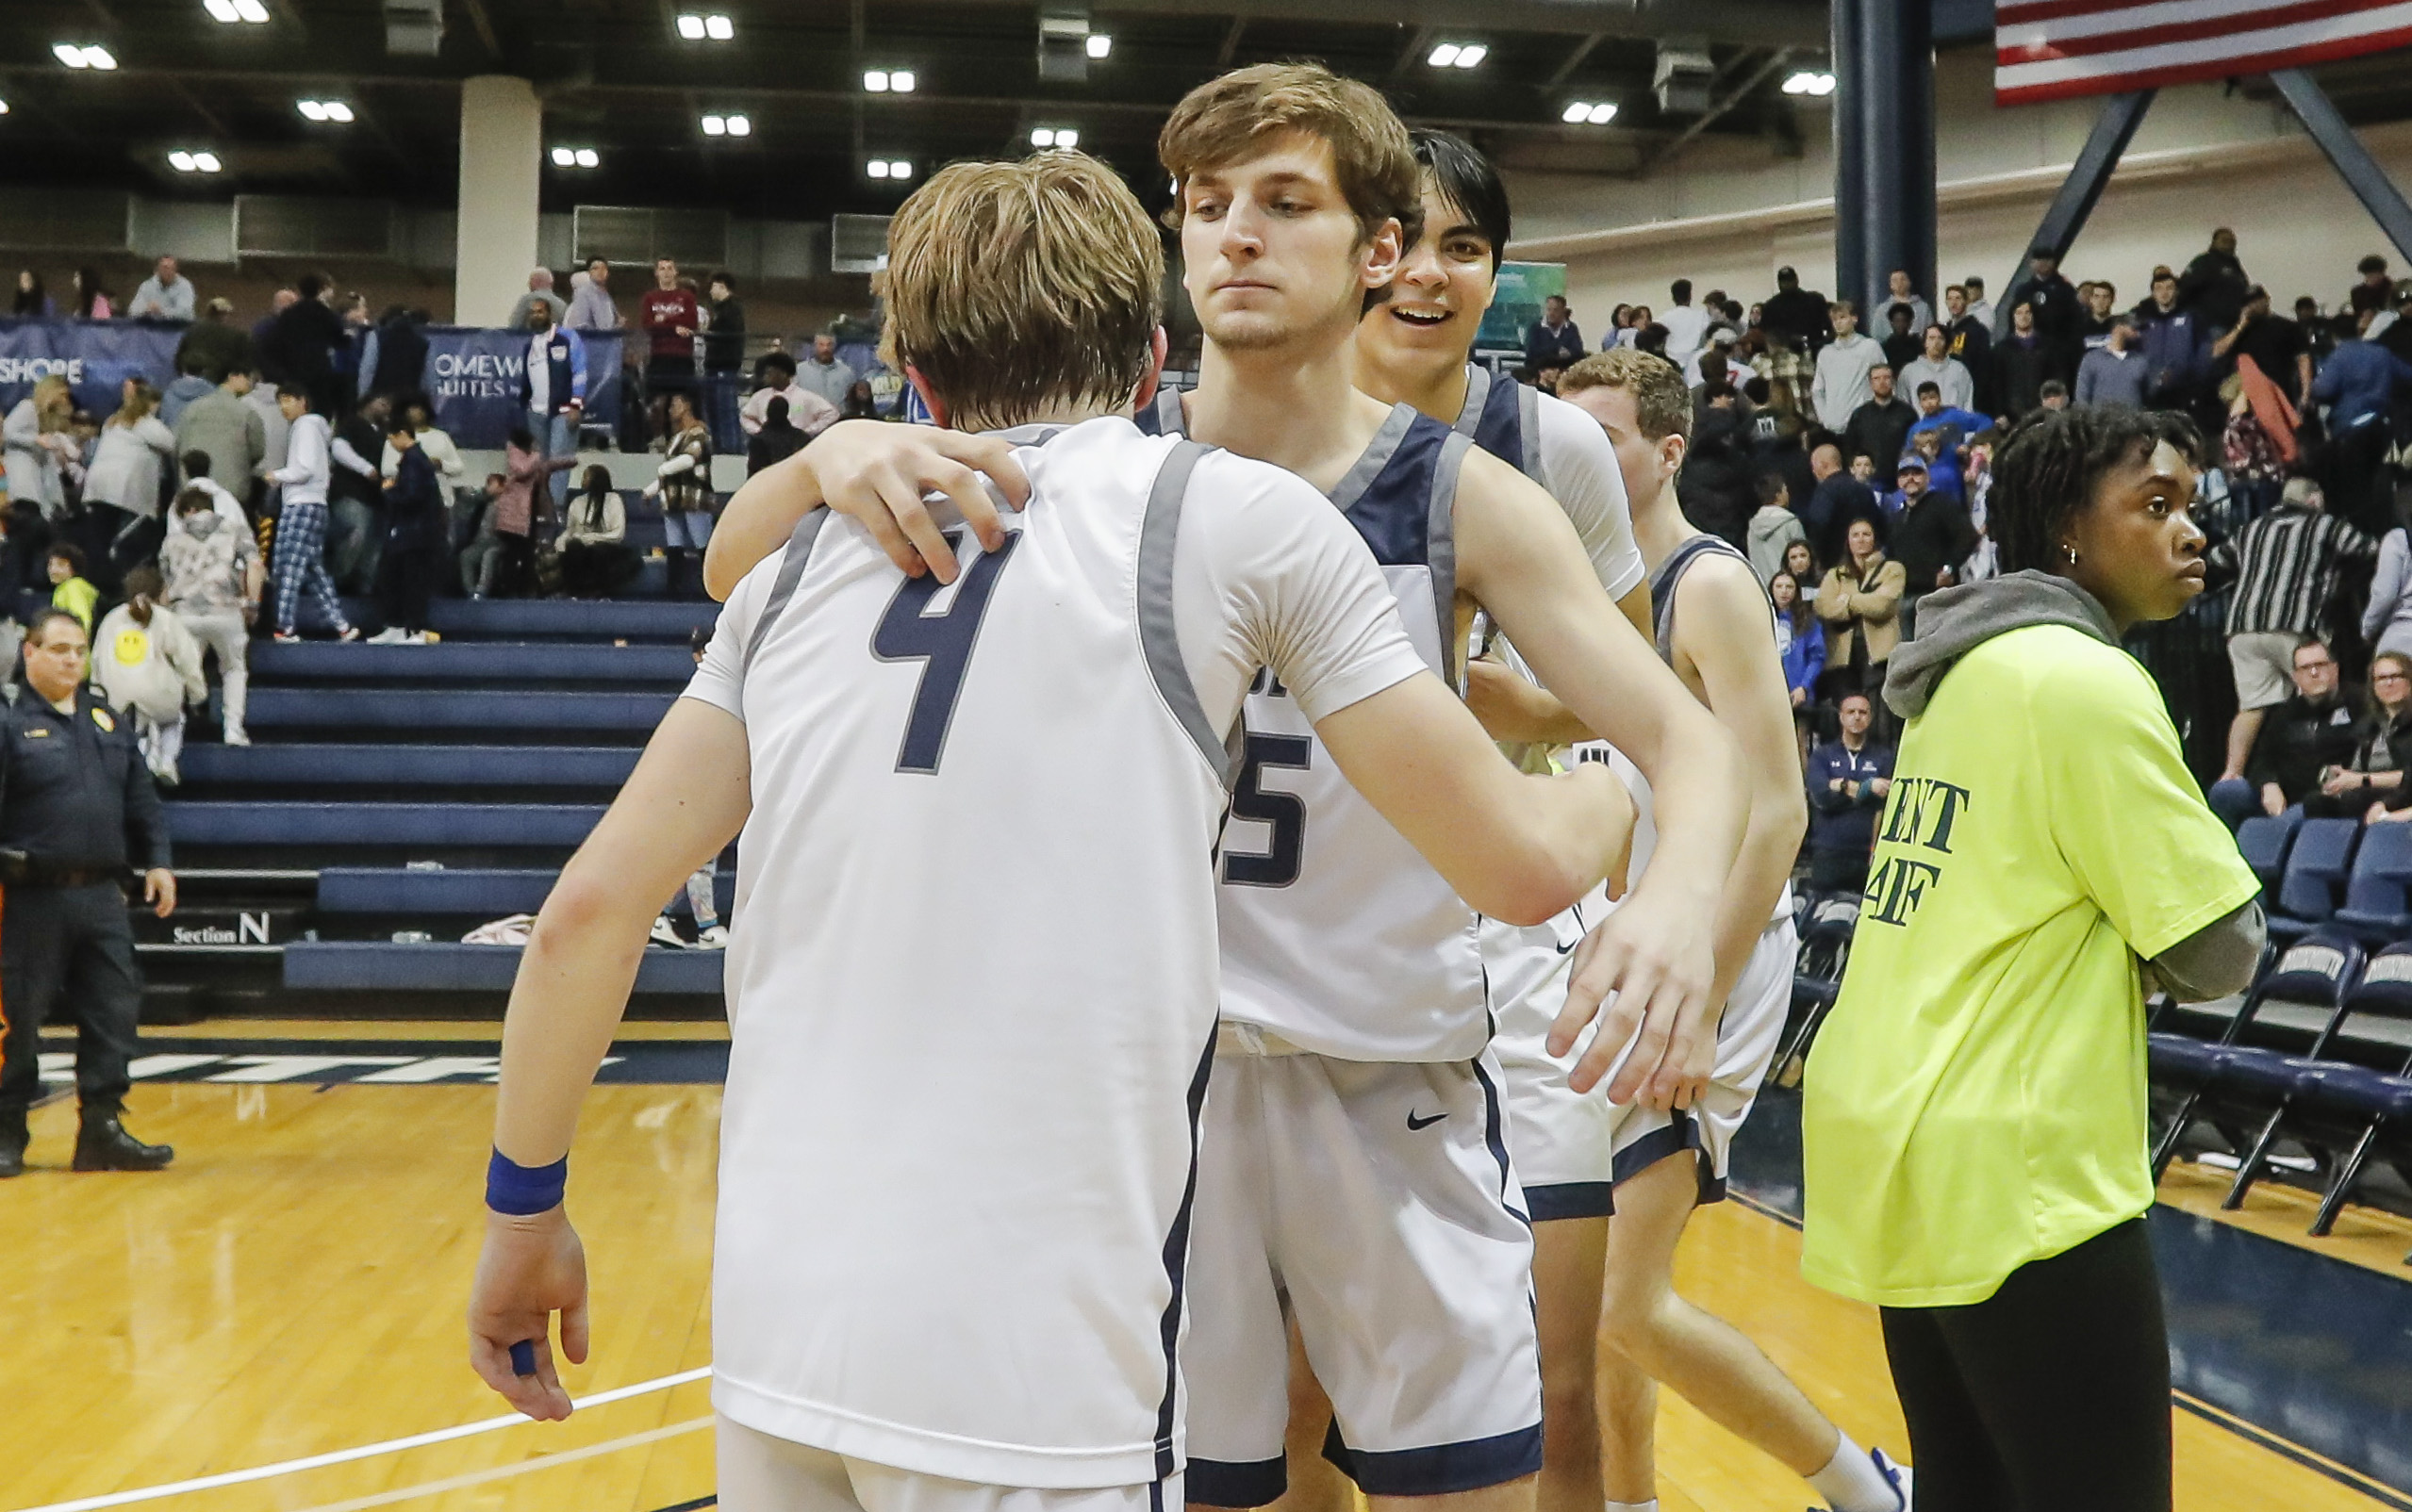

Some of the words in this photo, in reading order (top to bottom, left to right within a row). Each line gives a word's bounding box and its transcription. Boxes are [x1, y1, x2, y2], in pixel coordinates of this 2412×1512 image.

[868, 528, 1024, 777] 4
[1221, 731, 1313, 889] 5
[173, 926, 237, 945] Section
[239, 912, 270, 945] N
